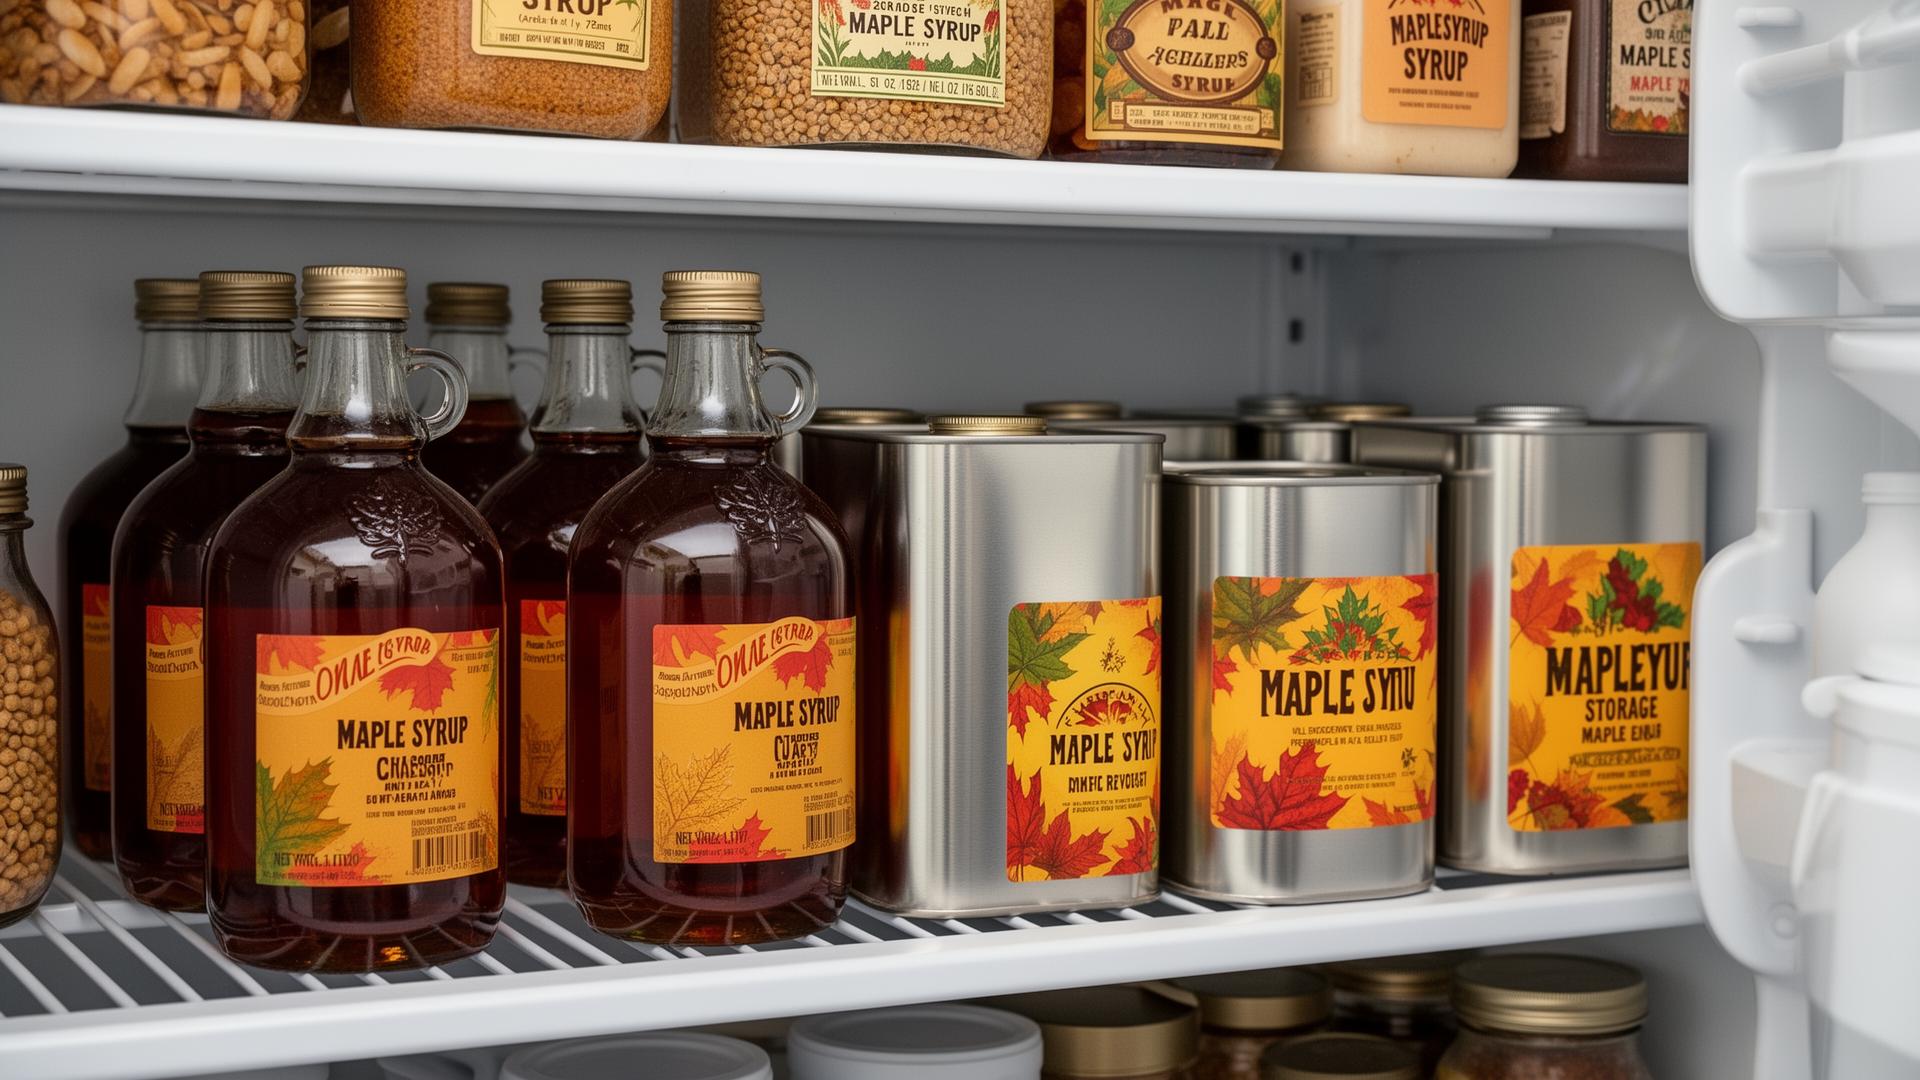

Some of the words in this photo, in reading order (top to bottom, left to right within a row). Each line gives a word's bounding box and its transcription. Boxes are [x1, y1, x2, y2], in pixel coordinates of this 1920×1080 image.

[850, 12, 915, 37] MAPLE
[924, 18, 981, 42] SYRUP
[1404, 47, 1468, 81] SYRUP
[1620, 44, 1677, 68] MAPLE
[1630, 75, 1672, 91] MAPLE
[1260, 668, 1354, 717] MAPLE
[733, 702, 794, 732] MAPLE
[800, 695, 840, 726] SYRUP
[1585, 696, 1658, 722] STORAGE
[337, 719, 405, 750] MAPLE
[412, 715, 468, 747] SYRUP
[1582, 728, 1626, 744] MAPLE
[1050, 732, 1114, 766] MAPLE
